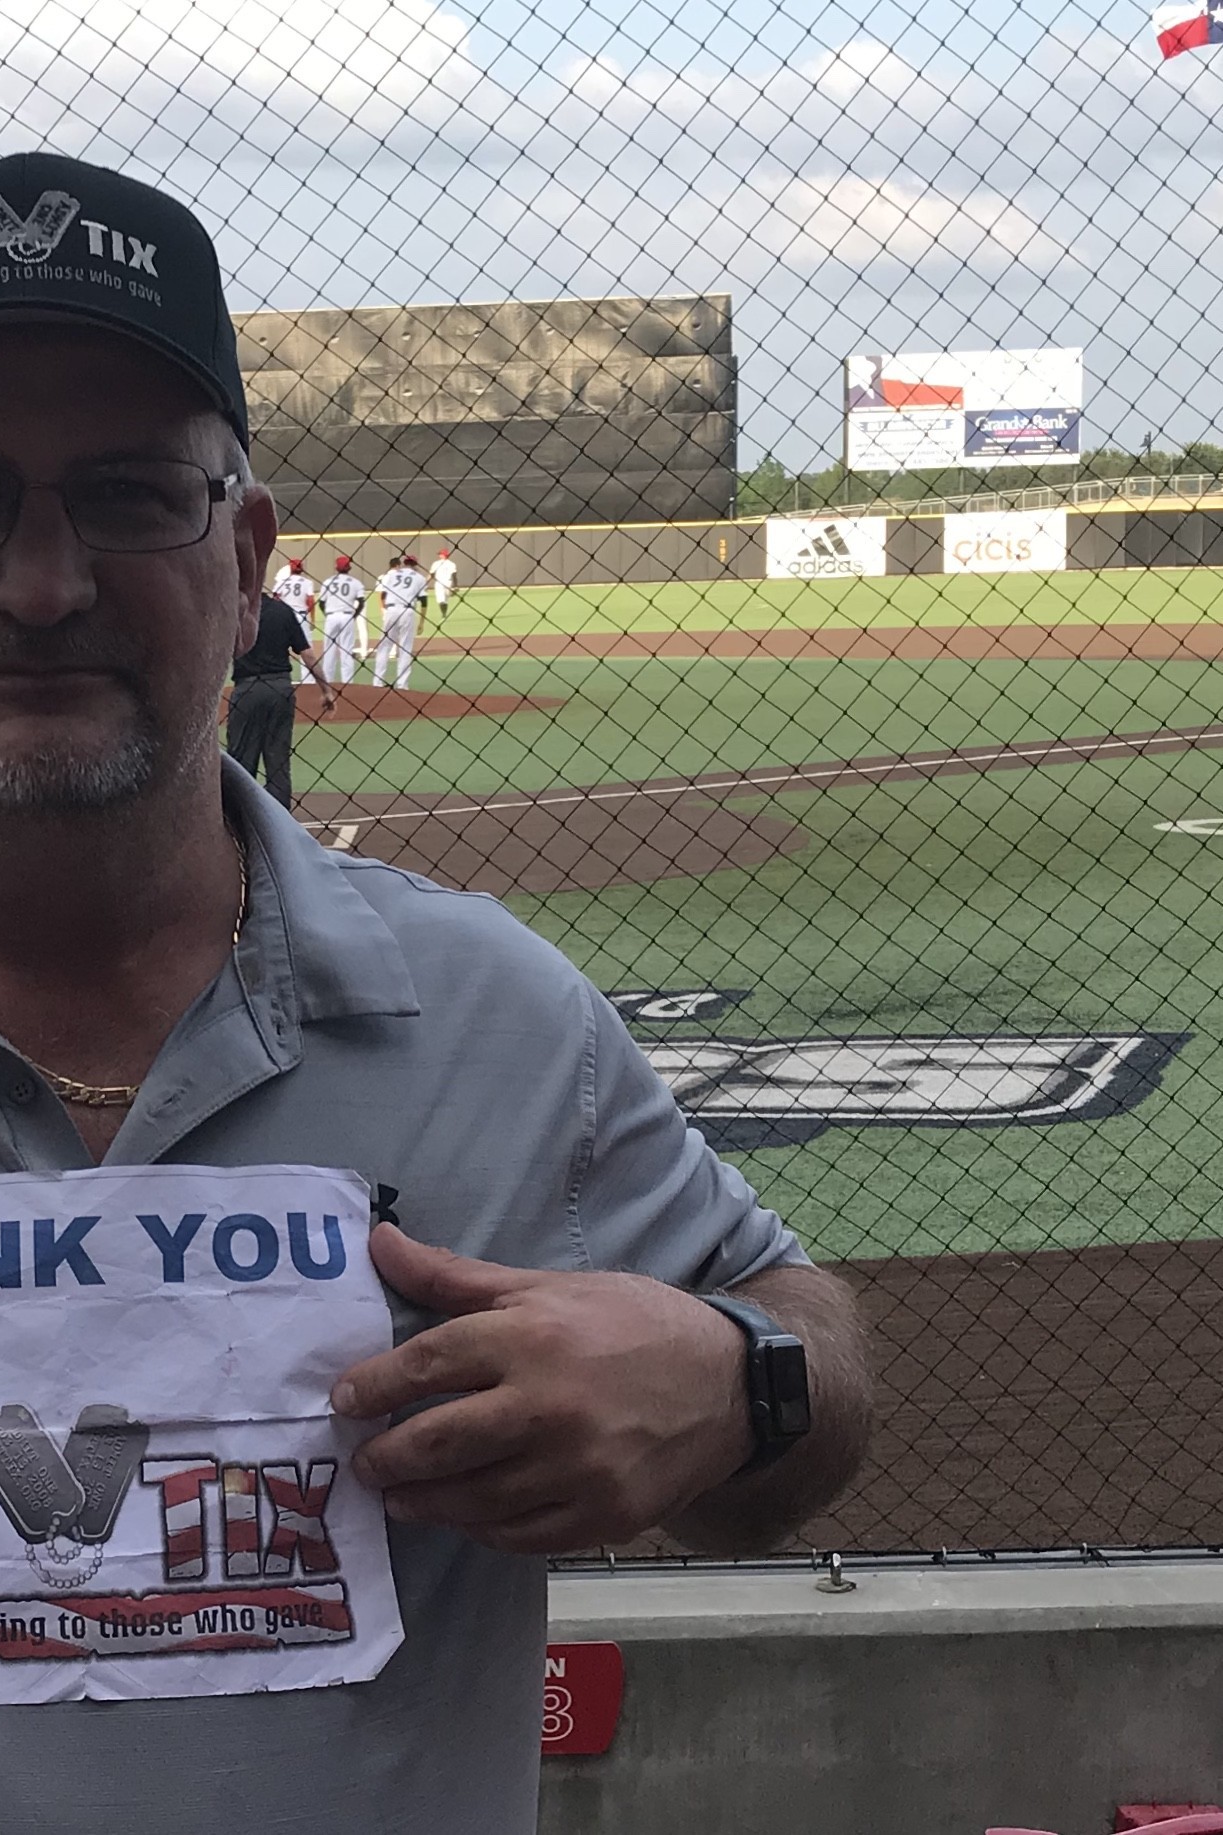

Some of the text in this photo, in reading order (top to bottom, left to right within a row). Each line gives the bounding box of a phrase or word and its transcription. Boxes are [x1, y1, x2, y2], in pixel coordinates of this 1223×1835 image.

[81, 220, 158, 278] TIX
[14, 265, 32, 279] to
[36, 263, 84, 280] those
[89, 268, 122, 290] who
[128, 280, 162, 307] gave
[975, 414, 1068, 432] Grand Bank
[393, 575, 413, 589] 39
[787, 557, 865, 576] adidas
[284, 583, 301, 597] 38
[135, 1211, 348, 1284] YOU
[139, 1453, 342, 1583] TIX
[58, 1612, 87, 1640] to
[97, 1609, 182, 1638] those
[192, 1603, 256, 1634] who
[264, 1600, 325, 1635] gave
